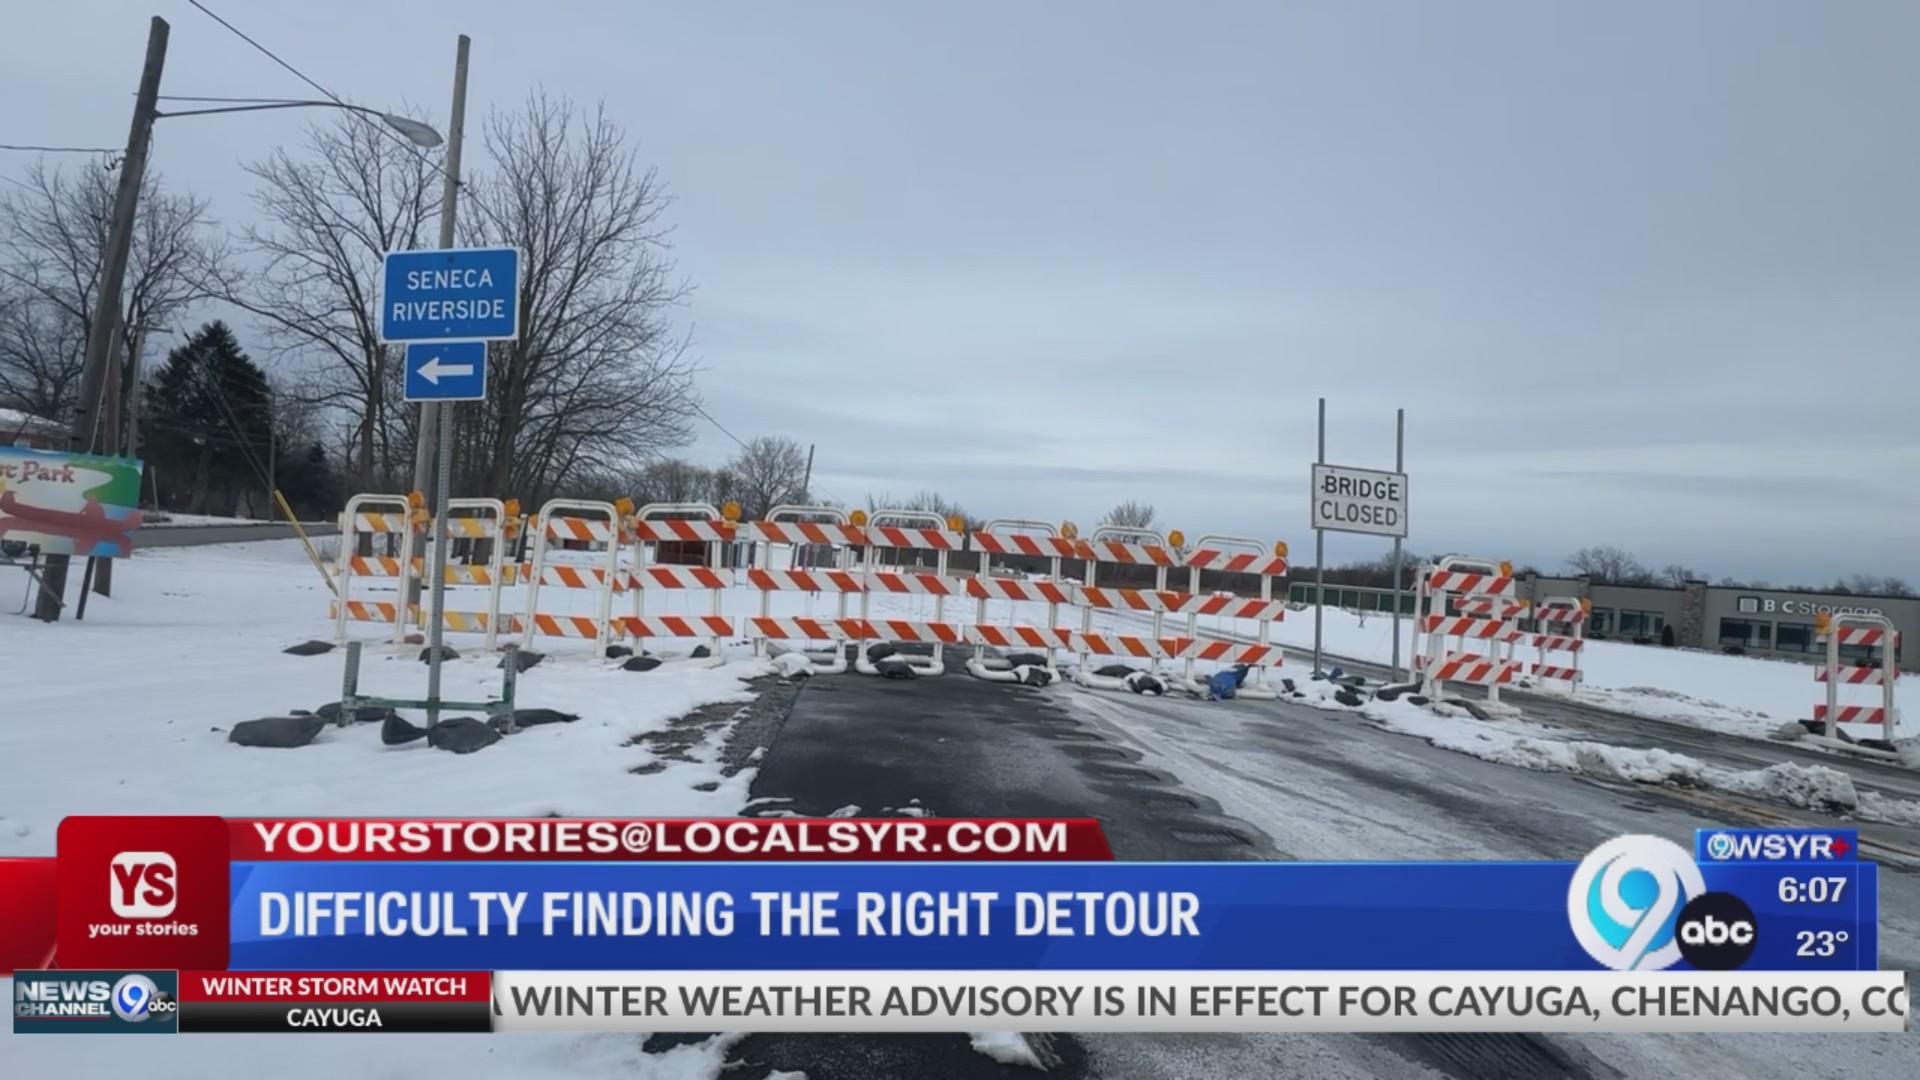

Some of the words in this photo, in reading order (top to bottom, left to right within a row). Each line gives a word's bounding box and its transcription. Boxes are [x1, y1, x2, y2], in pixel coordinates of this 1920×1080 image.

[407, 269, 494, 290] SENECA
[392, 299, 505, 322] RIVERSIDE
[17, 460, 75, 484] Park
[1324, 475, 1400, 501] BRIDGE
[1320, 500, 1398, 527] CLOSED
